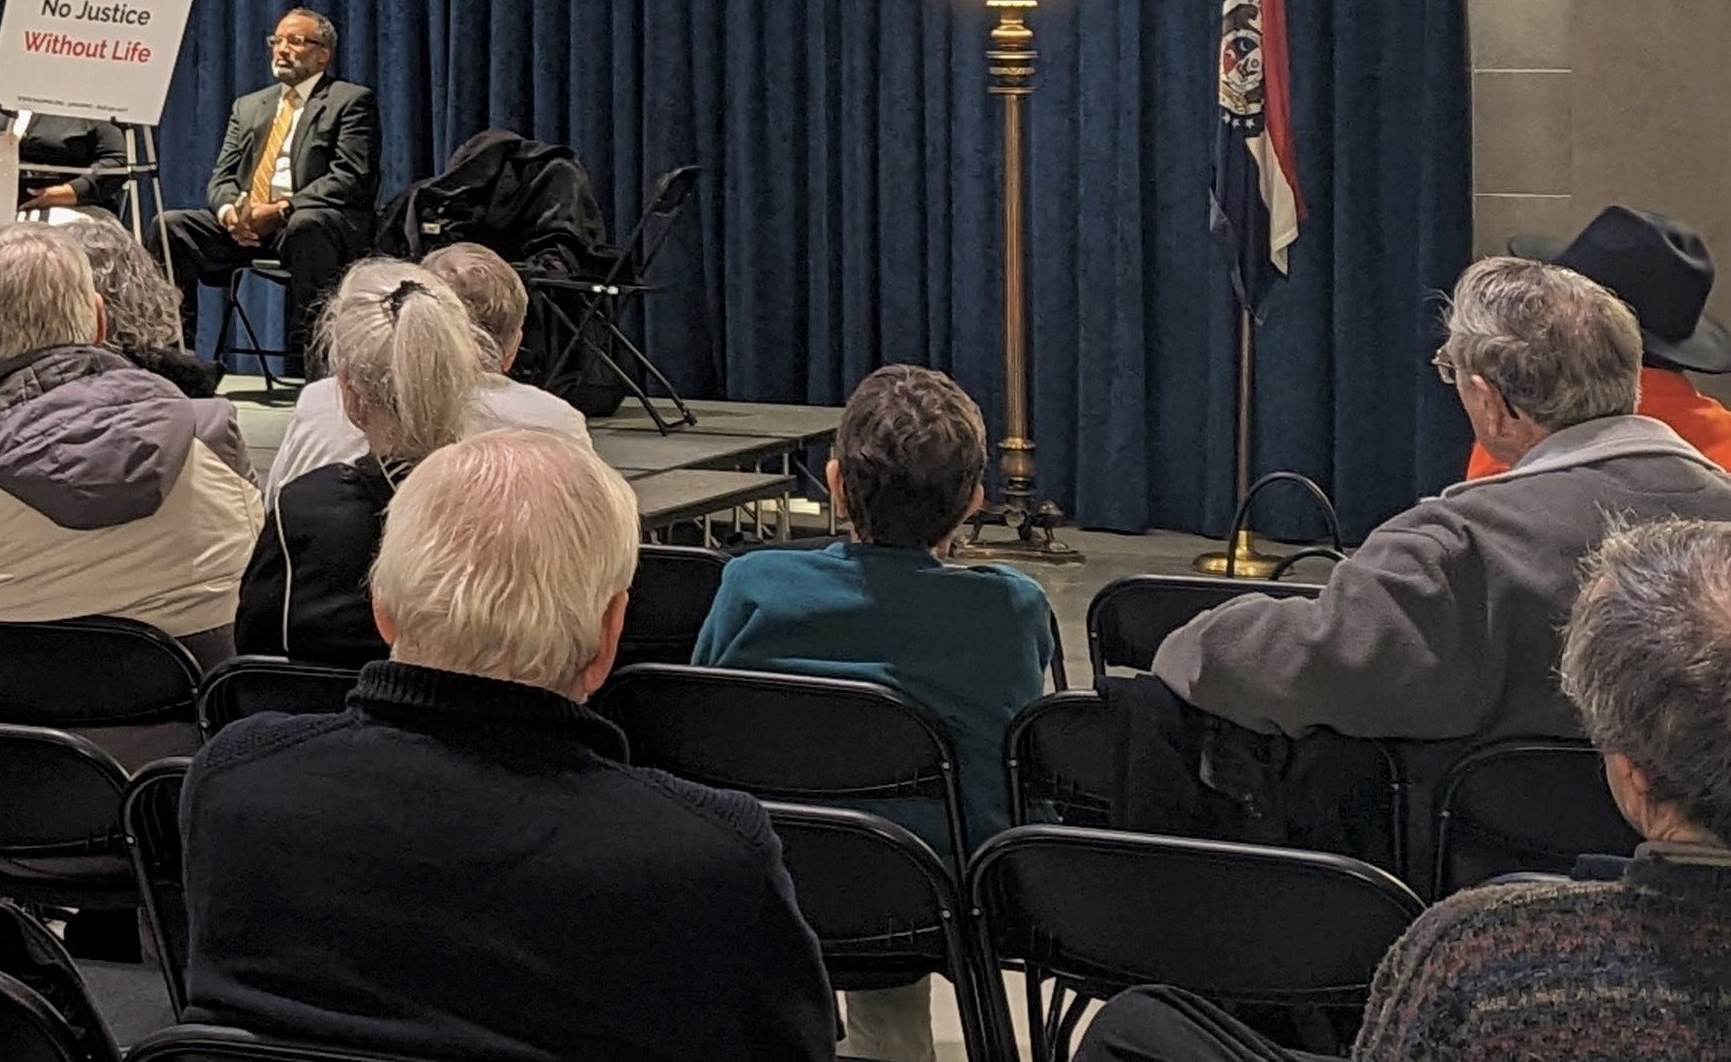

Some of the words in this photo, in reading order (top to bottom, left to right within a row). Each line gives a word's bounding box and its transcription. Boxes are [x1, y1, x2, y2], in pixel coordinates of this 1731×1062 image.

[75, 0, 151, 26] Justice
[24, 31, 108, 59] Without
[112, 41, 151, 63] Life
